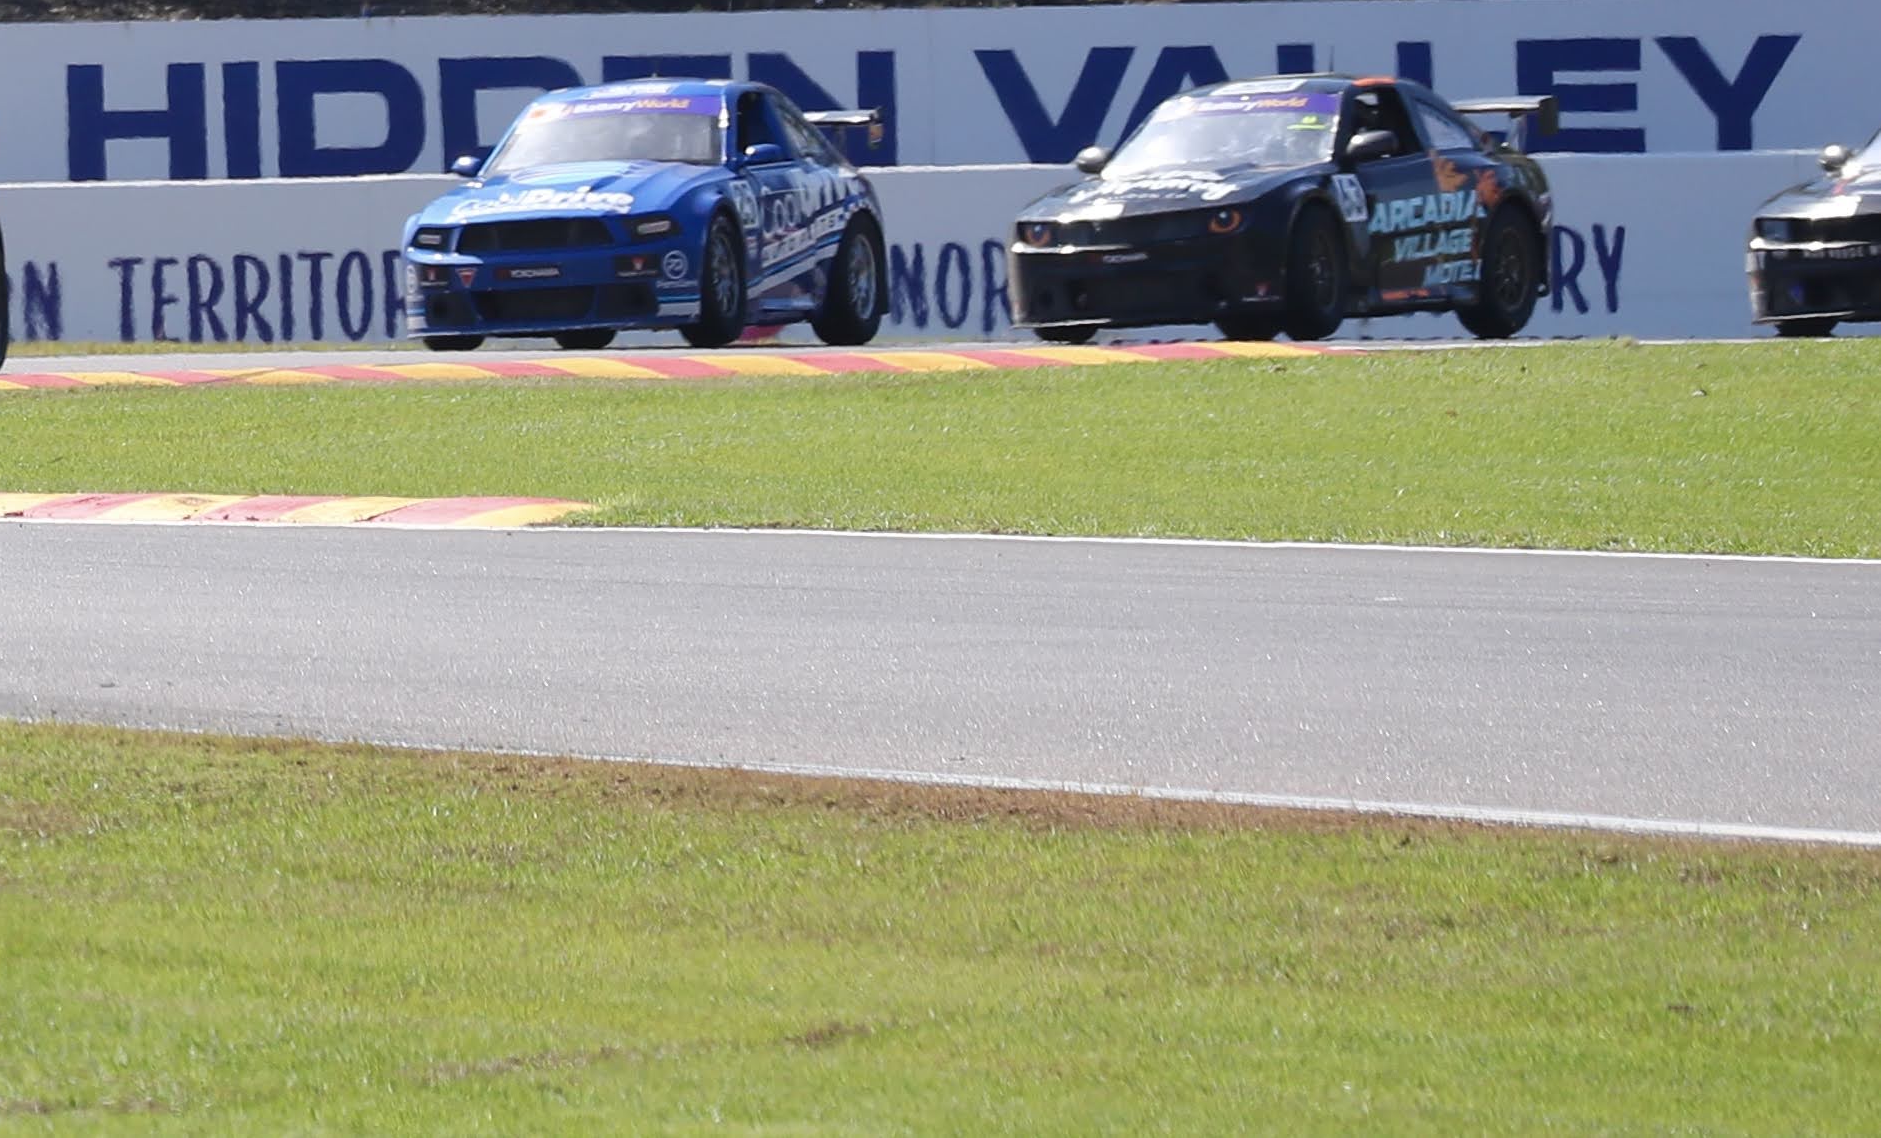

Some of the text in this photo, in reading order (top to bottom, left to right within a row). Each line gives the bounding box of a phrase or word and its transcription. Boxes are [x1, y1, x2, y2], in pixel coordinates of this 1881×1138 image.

[67, 32, 1802, 182] HIDDN VAEY
[1394, 227, 1475, 263] VILLAGE
